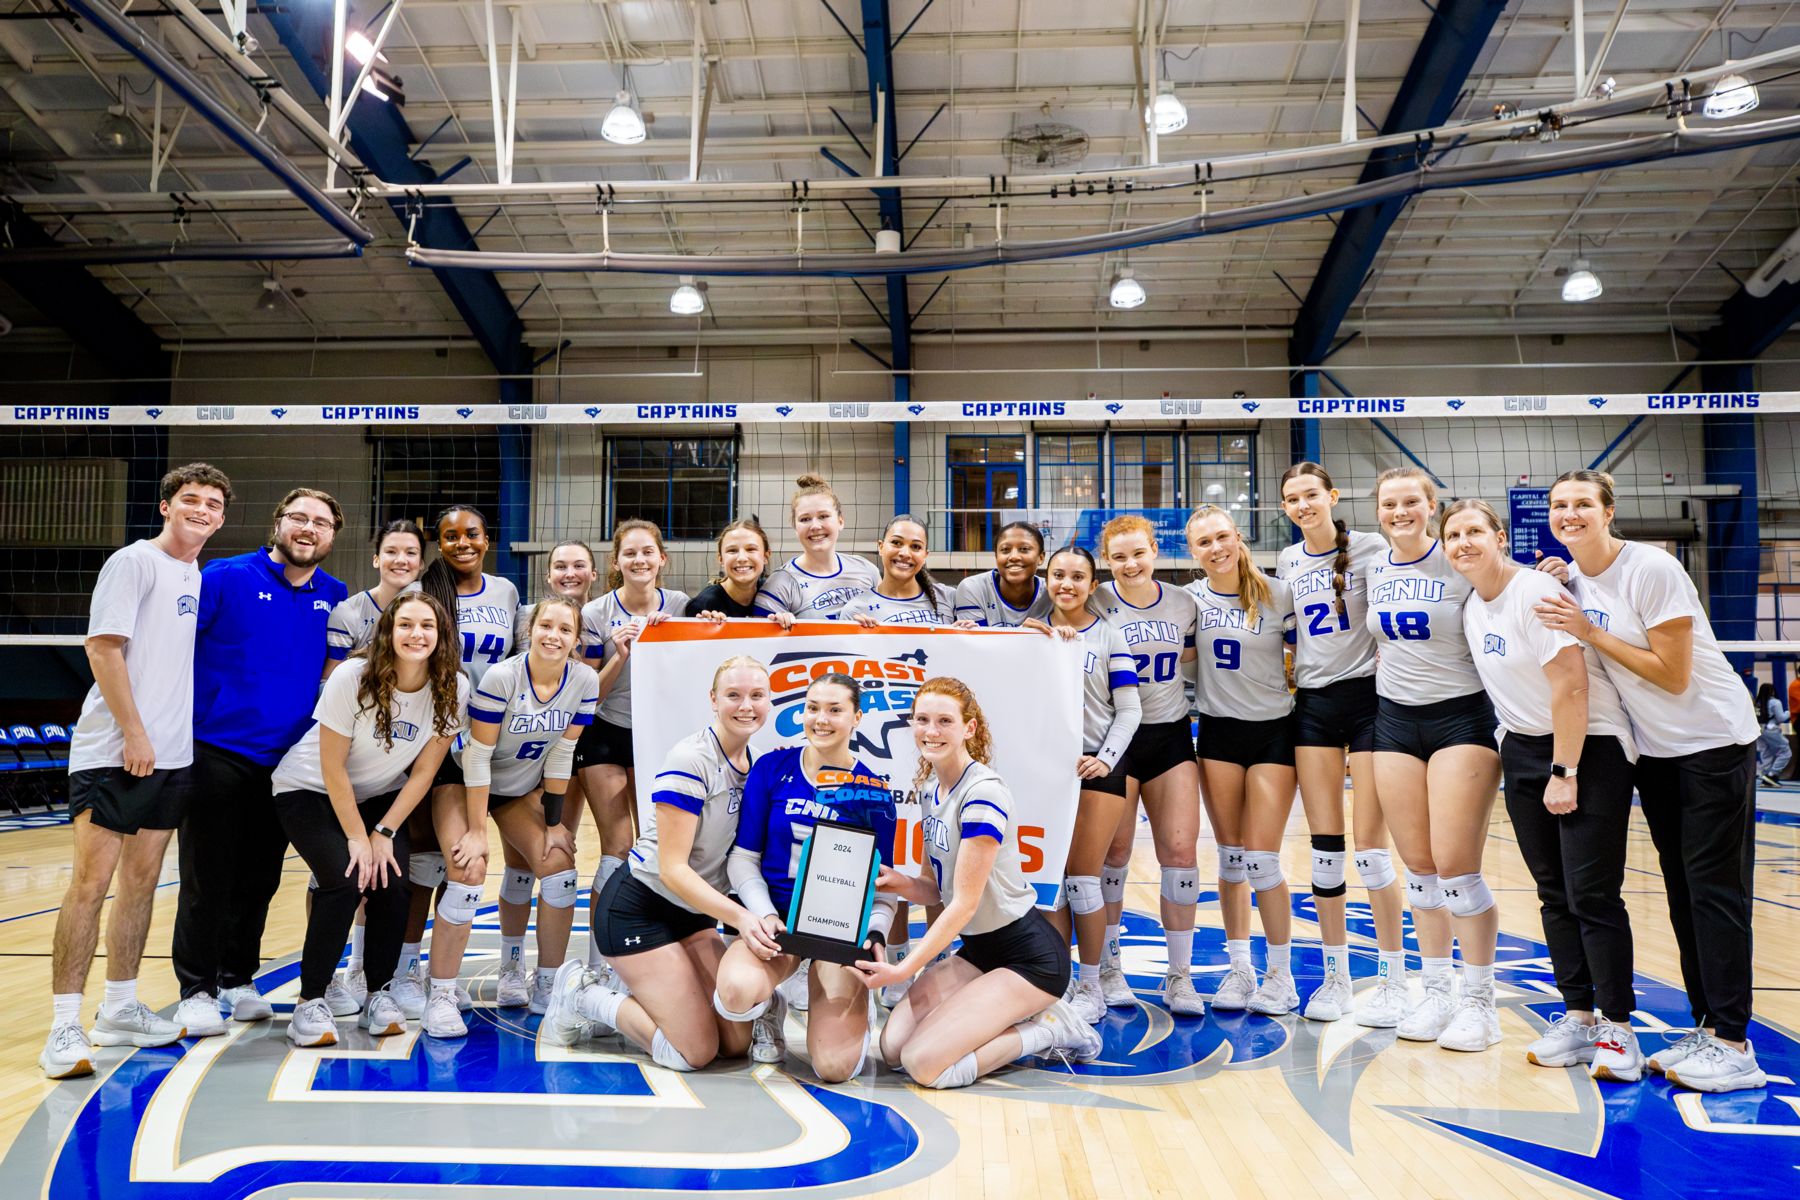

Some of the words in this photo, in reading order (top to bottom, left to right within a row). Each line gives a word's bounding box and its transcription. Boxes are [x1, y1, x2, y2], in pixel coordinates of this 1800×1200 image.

[14, 406, 110, 420] CAPTAINS
[196, 406, 235, 420] CNU
[321, 406, 419, 420] CAPTAINS
[508, 405, 548, 420] CNU
[637, 405, 738, 419] CAPTAINS
[828, 403, 869, 418] CNU
[962, 402, 1065, 416] CAPTAINS
[1160, 401, 1202, 415] CNU
[1298, 398, 1406, 413] CAPTAINS
[1504, 396, 1547, 411] CNU
[1647, 393, 1760, 409] CAPTAINS
[1372, 578, 1445, 604] CNU
[177, 594, 197, 616] CN
[313, 599, 331, 614] CNU
[457, 606, 510, 629] CNU
[1200, 608, 1264, 636] CNU
[1303, 601, 1351, 637] 21
[1377, 611, 1432, 640] 18
[1121, 620, 1180, 646] CNU
[1484, 633, 1506, 656] CNU
[459, 631, 505, 664] 14
[1212, 637, 1242, 671] 9
[769, 659, 926, 693] COAST
[1131, 651, 1179, 684] 20
[508, 711, 572, 734] CNU
[775, 690, 918, 737] CAS
[13, 726, 36, 740] CNU
[44, 725, 66, 739] CNU
[515, 740, 549, 761] 6
[816, 771, 889, 790] COAST
[815, 788, 891, 805] COAST
[784, 798, 840, 822] CNU
[833, 843, 852, 853] 2024
[816, 874, 857, 888] VOLLEYBALL
[807, 915, 850, 929] CHAMPIONS
